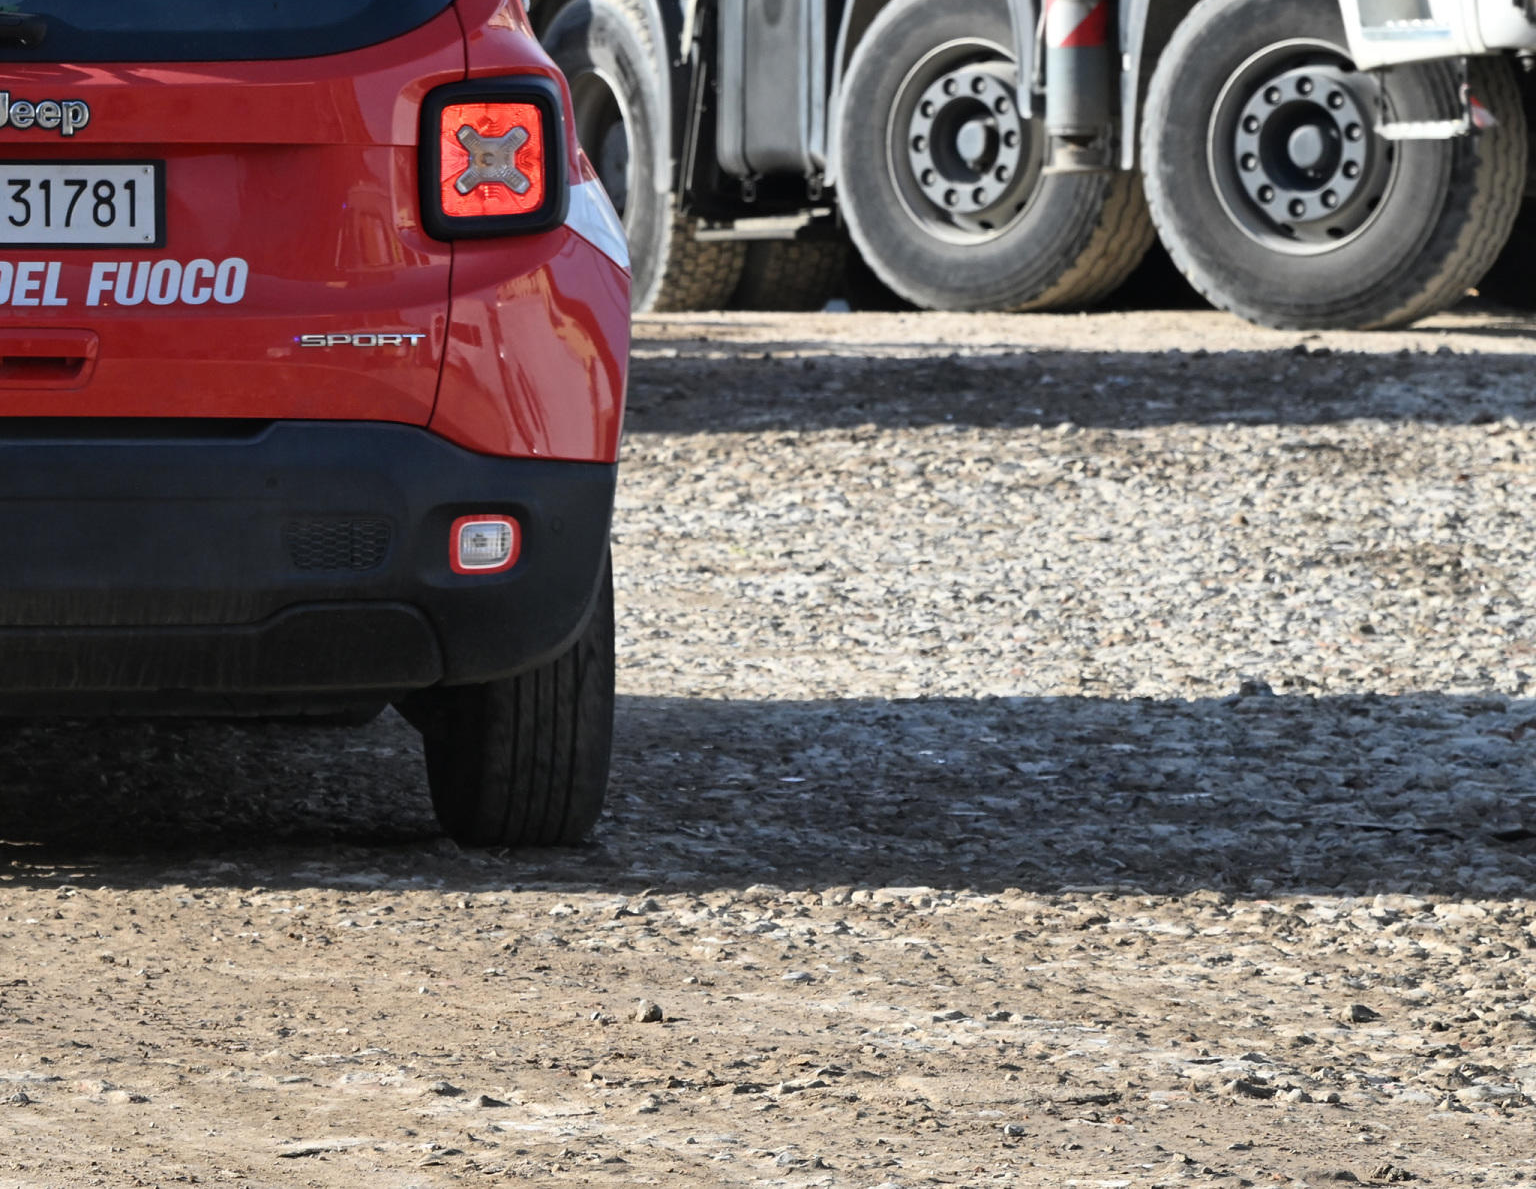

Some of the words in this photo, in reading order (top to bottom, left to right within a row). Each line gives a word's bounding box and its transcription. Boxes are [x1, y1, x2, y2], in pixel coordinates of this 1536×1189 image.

[7, 178, 137, 228] 31781
[85, 256, 249, 307] FUOCO
[300, 333, 427, 347] SPORT
